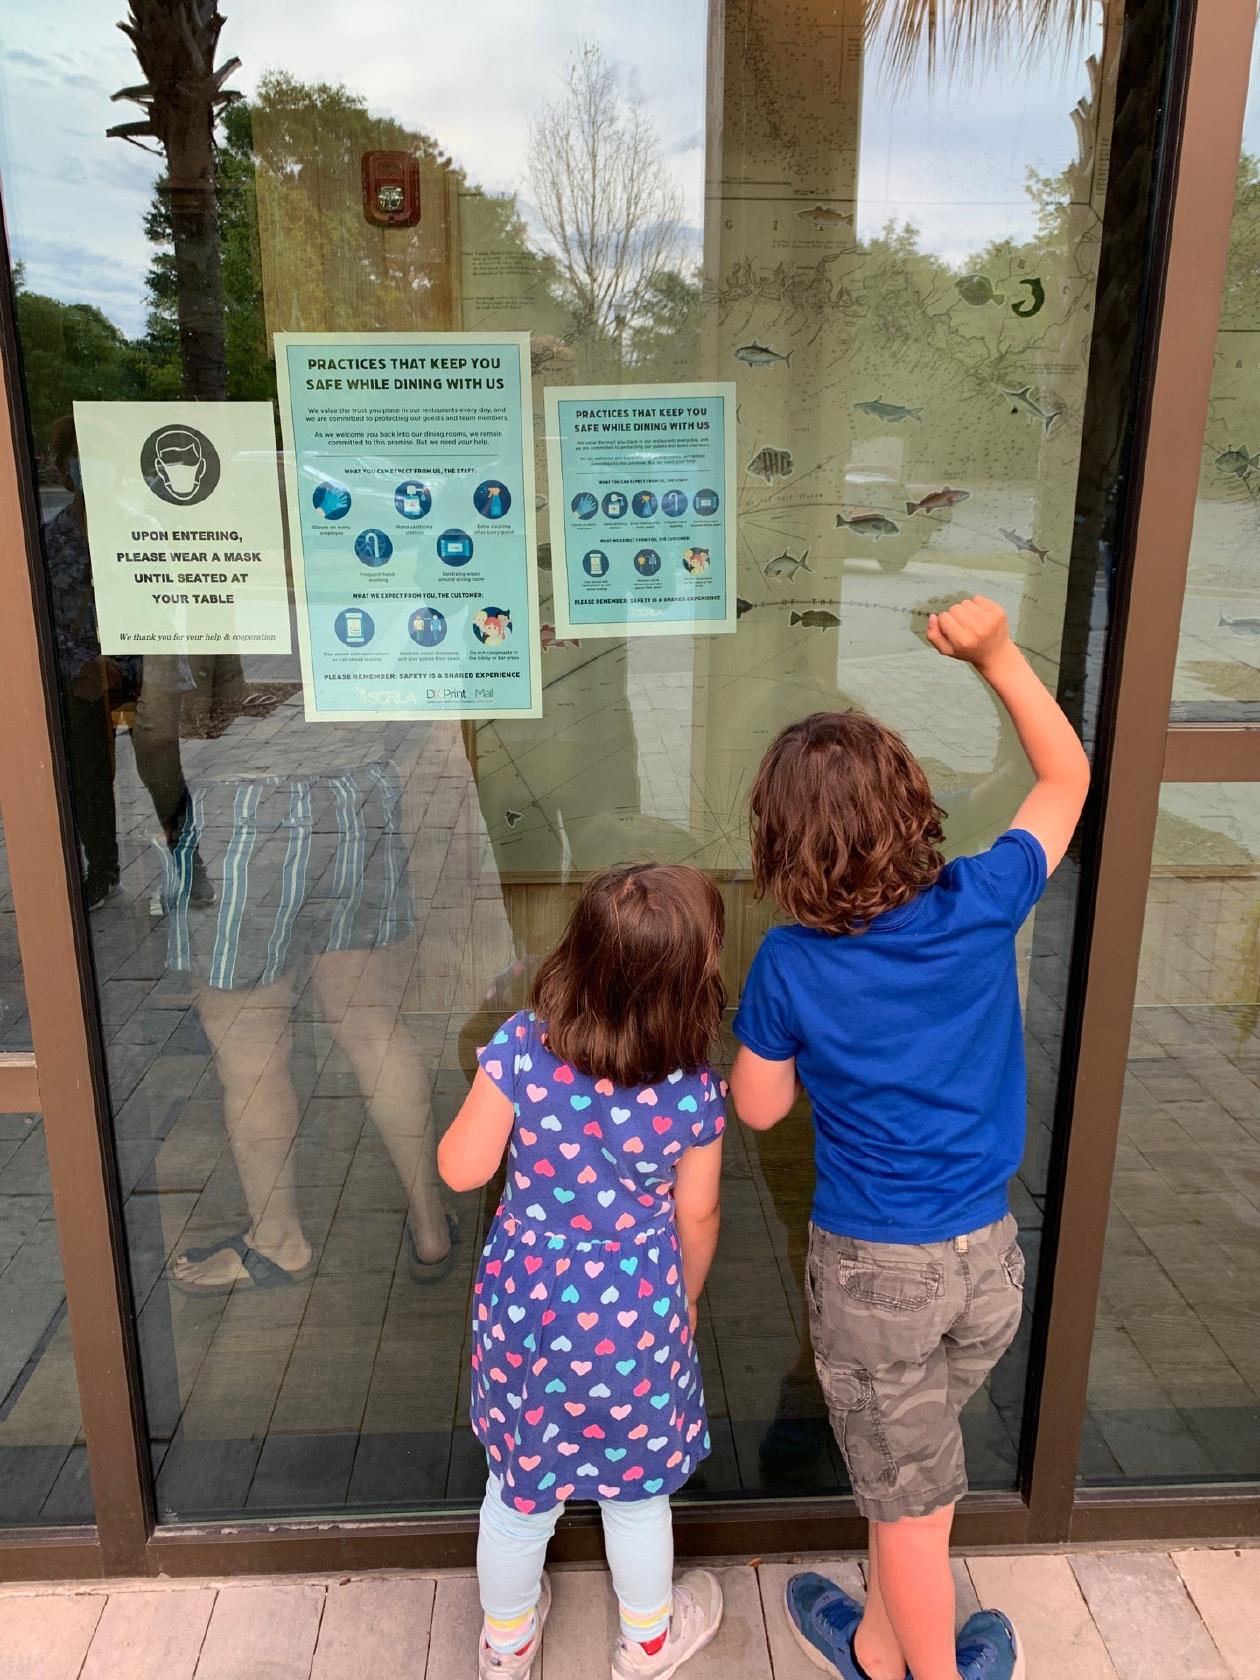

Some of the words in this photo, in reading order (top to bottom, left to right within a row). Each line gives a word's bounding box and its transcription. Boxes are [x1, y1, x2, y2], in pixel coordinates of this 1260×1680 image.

[308, 359, 386, 369] PRACTICES
[390, 358, 425, 369] THAT
[430, 358, 467, 369] KEEP
[470, 358, 500, 368] YOU
[306, 379, 342, 390] SAFE
[347, 379, 389, 390] WHILE
[394, 379, 442, 390] DINING
[446, 379, 480, 389] WITH
[486, 379, 504, 389] US
[576, 410, 629, 419] PRACTICES
[632, 409, 656, 418] THAT
[659, 409, 684, 417] KEEP
[686, 408, 707, 417] YOU
[574, 423, 600, 432] SAFE
[602, 423, 631, 432] WHILE
[633, 422, 667, 431] DINING
[669, 421, 695, 430] WITH
[697, 421, 710, 430] US
[132, 531, 168, 540] UPON
[173, 531, 242, 542] ENTERING,
[117, 553, 166, 562] PLEASE
[170, 553, 207, 562] WEAR
[212, 553, 220, 562] A
[224, 553, 262, 562] MASK
[135, 574, 173, 583] UNTIL
[177, 574, 228, 583] SEATED
[231, 574, 248, 583] AT
[152, 594, 189, 604] YOUR
[192, 594, 234, 604] TABLE
[133, 633, 156, 641] thank
[171, 633, 183, 642] for
[205, 634, 222, 642] help
[232, 634, 276, 642] cooperation
[444, 689, 466, 698] Print
